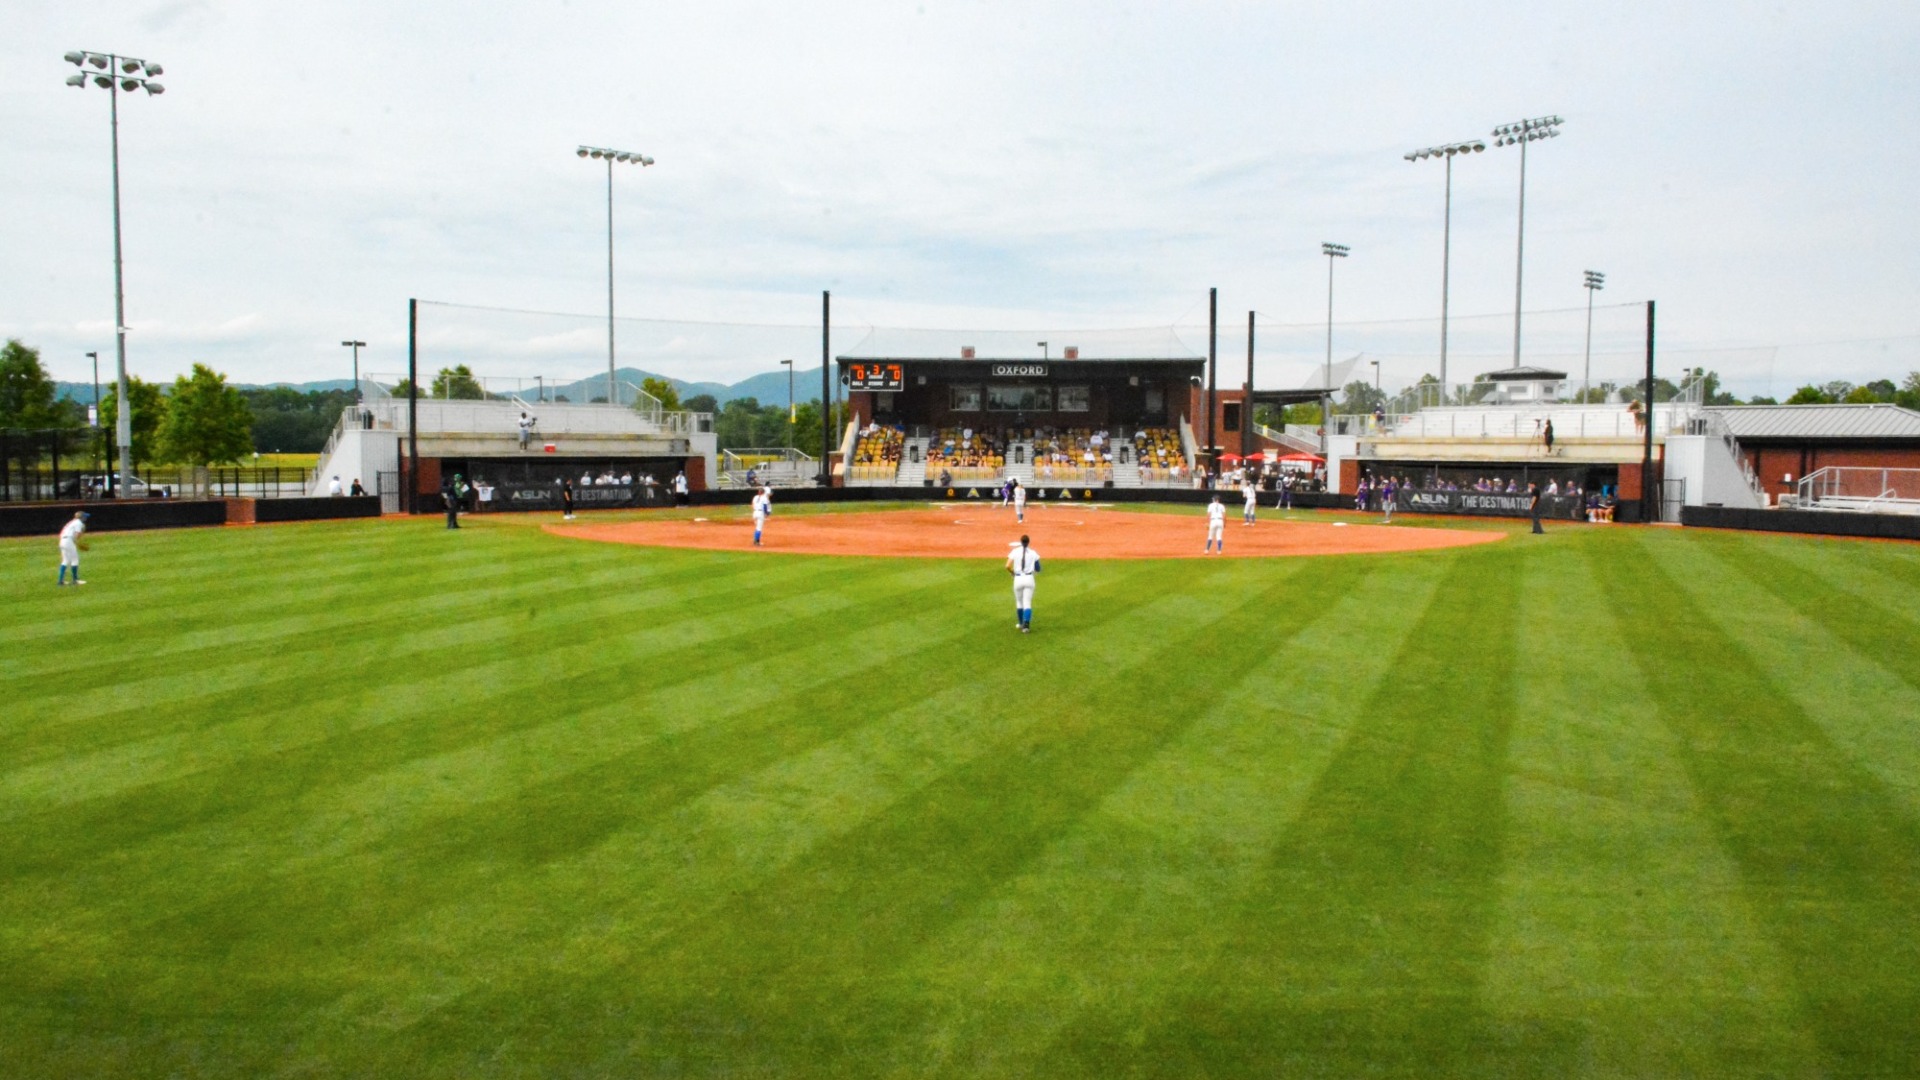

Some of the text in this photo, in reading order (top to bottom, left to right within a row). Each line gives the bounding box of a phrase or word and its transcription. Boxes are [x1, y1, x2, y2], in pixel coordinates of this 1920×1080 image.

[857, 369, 864, 380] 0
[894, 370, 901, 380] 0
[997, 365, 1044, 375] OXFORD
[512, 490, 551, 500] ASUN
[1410, 493, 1449, 504] ASUN
[1461, 496, 1532, 511] THE DESTINATIO
